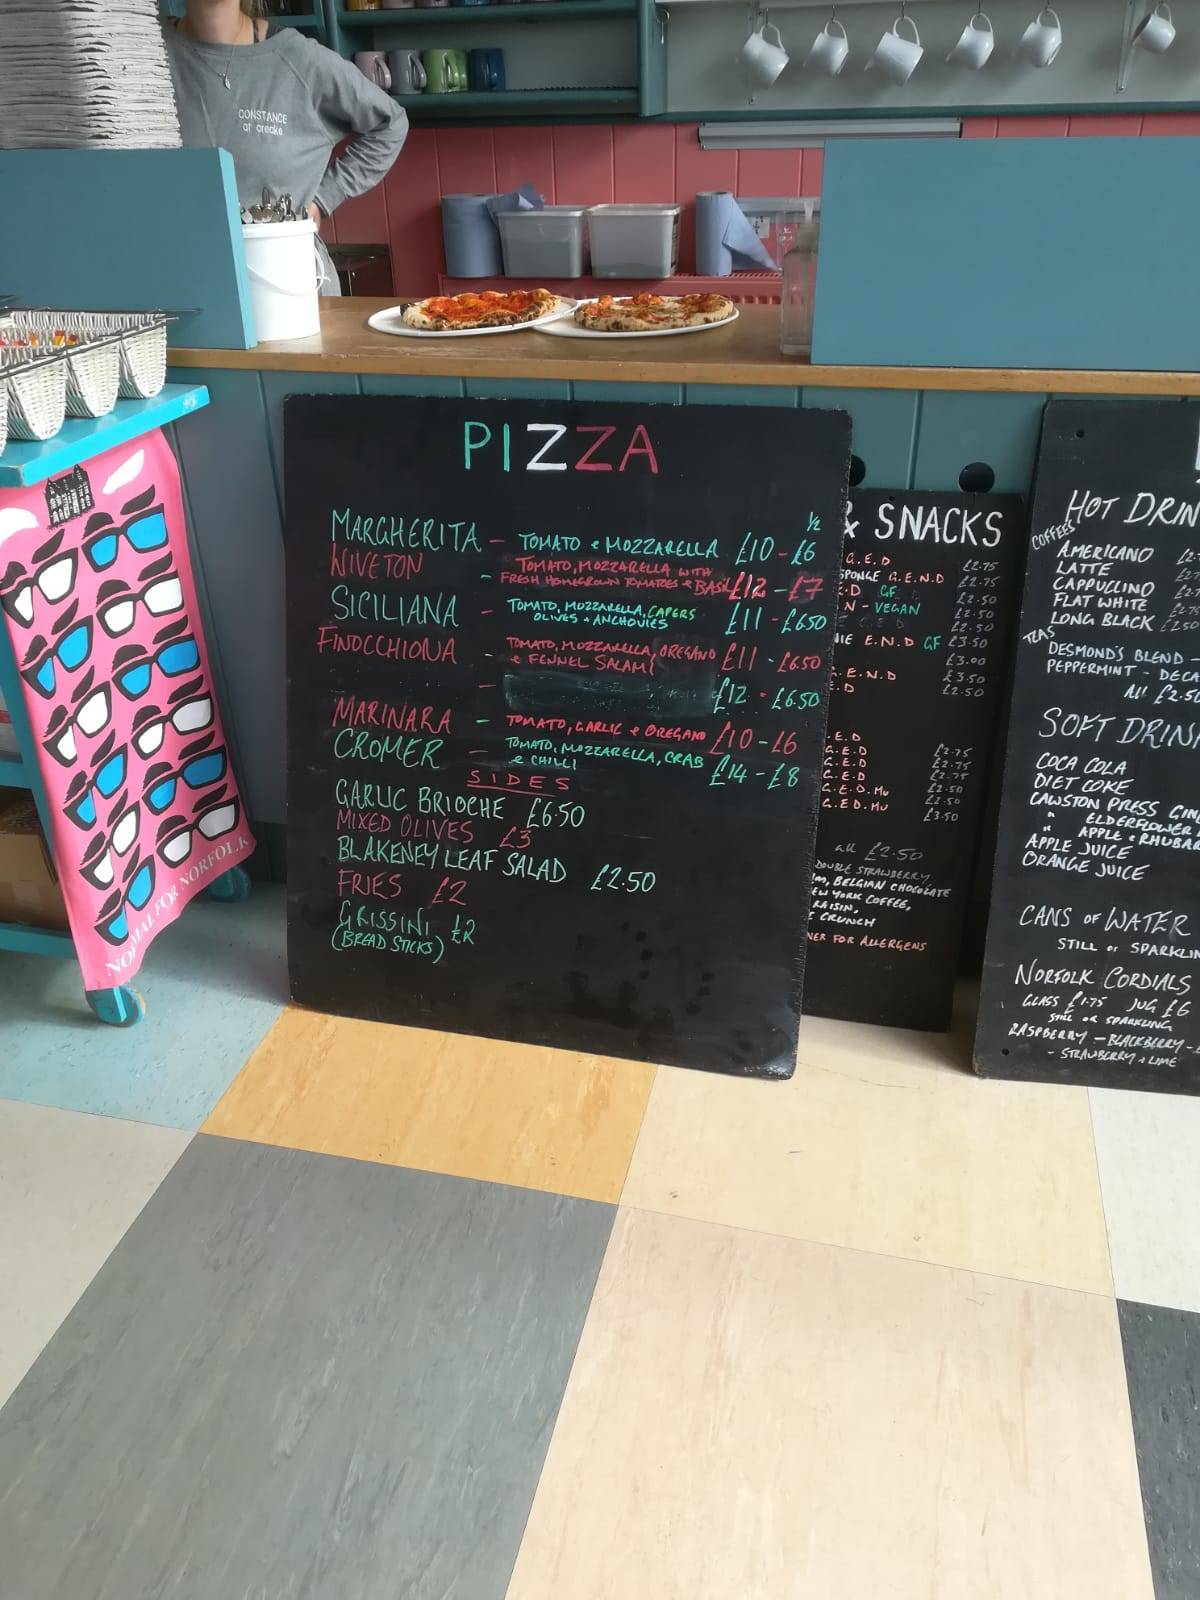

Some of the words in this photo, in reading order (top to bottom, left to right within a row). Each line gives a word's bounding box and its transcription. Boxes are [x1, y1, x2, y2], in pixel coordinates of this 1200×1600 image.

[238, 109, 288, 125] CONSTANCE
[242, 123, 251, 133] at
[464, 421, 659, 474] PIZZA
[1064, 490, 1120, 524] HOT
[874, 502, 1003, 547] SNACKS
[332, 507, 482, 553] MARGHERITA
[518, 532, 581, 553] TOMATO
[605, 536, 719, 559] MOZZARELLA
[735, 532, 775, 565] £10
[790, 539, 816, 567] £6
[1031, 519, 1077, 552] COFFEES
[1057, 540, 1155, 563] AMERICANO
[962, 559, 1000, 572] £2.75
[1056, 560, 1114, 577] LATTE
[500, 571, 541, 585] FRESH
[545, 574, 620, 588] HOMEGROWN
[515, 556, 578, 574] TOMATO,
[578, 559, 671, 577] MOZZARELLA
[728, 571, 767, 601] £12
[788, 575, 824, 603] £7
[957, 575, 1001, 588] £2.75
[1053, 576, 1155, 598] CAPPUCCINO
[879, 584, 898, 599] GF
[956, 591, 998, 605] £2.50
[1052, 591, 1095, 608] FLAT
[1097, 596, 1148, 612] WHITE
[331, 584, 459, 628] SICILIANA
[506, 597, 560, 613] TOMATO,
[564, 600, 647, 617] MOZZARELLA,
[647, 604, 697, 621] CAPERS
[724, 602, 763, 636] £11
[874, 601, 921, 615] VEGAN
[954, 607, 995, 620] £2.50
[533, 612, 578, 624] OLIVES
[592, 613, 669, 630] ANCHOVIES
[950, 621, 995, 633] £2.50
[1050, 611, 1095, 626] LONG
[1101, 612, 1156, 632] BLACK
[922, 636, 943, 651] GF
[947, 635, 988, 649] £3.50
[1022, 625, 1056, 645] TEAS
[317, 626, 458, 665] FINOCCHIONA
[506, 637, 559, 653] TOMATO,
[562, 640, 657, 659] MOZZARELLA,
[659, 644, 716, 662] OREGANO
[720, 643, 758, 673] £11
[777, 652, 822, 673] £6.50
[945, 653, 987, 667] £3.00
[1048, 641, 1125, 662] DESMOND'S
[1134, 649, 1184, 665] BLEND
[528, 654, 591, 669] FENNEL
[1047, 659, 1138, 677] PEPPERMINT
[943, 668, 986, 684] £3.50
[713, 677, 748, 714] £12
[771, 687, 820, 710] £6.50
[942, 683, 985, 697] £2.50
[332, 696, 451, 734] MARINARA
[506, 714, 572, 735] TOMATO,
[575, 721, 623, 736] GARLIC
[644, 724, 706, 742] OREGANO
[709, 720, 753, 756] £10
[771, 730, 798, 756] £6
[1038, 705, 1117, 742] SOFT
[333, 728, 443, 770] CROMER
[505, 736, 558, 754] TOMATO,
[561, 743, 661, 767] MOZZARELLA,
[664, 752, 705, 769] CRAB
[709, 753, 748, 787] £14
[768, 763, 800, 790] £8
[933, 743, 974, 758] £2.75
[531, 757, 577, 771] CHILLI
[931, 757, 973, 771] £2.75
[1035, 751, 1079, 772] COCA
[1083, 757, 1128, 776] COLA
[927, 782, 964, 794] £2.50
[1034, 772, 1081, 791] DIET
[1081, 778, 1135, 796] COKE
[336, 778, 407, 812] GARLIC
[418, 786, 507, 821] BRIOCHE
[525, 797, 585, 829] £6.50
[924, 794, 961, 806] £2.50
[1029, 791, 1100, 810] CAWSTON
[1106, 797, 1161, 818] PRESS
[922, 807, 959, 822] £3.50
[1085, 812, 1193, 836] ELDERFLOWER
[336, 809, 391, 834] MIXED
[400, 813, 474, 844] OLIVES
[498, 826, 533, 849] £3
[1077, 825, 1123, 842] APPLE
[863, 841, 924, 862] £2.50
[1024, 832, 1073, 853] APPLE
[1078, 842, 1134, 860] JUICE
[337, 835, 440, 870] BLAKENEY
[444, 847, 499, 873] LEAF
[501, 852, 567, 884] SALAD
[590, 863, 657, 893] £2.50
[814, 859, 853, 875] DOUBLE
[1022, 850, 1091, 873] ORANGE
[1095, 862, 1152, 881] JUICE
[154, 884, 180, 917] FOR
[178, 834, 250, 891] NORFOLK
[337, 868, 402, 900] FRIES
[430, 875, 468, 907] £2
[831, 889, 863, 901] YORK
[832, 875, 887, 891] BELGIAN
[889, 882, 952, 898] CHOCOLATE
[338, 899, 430, 937] GRISSINI
[450, 914, 476, 945] £2
[819, 911, 877, 928] CRUNCH
[1019, 904, 1073, 928] CANS
[1104, 906, 1192, 937] WATER
[832, 934, 855, 945] FOR
[859, 935, 928, 952] ALLERGENS
[1057, 937, 1099, 952] STILL
[1014, 957, 1096, 986] NORFOLK
[1103, 966, 1193, 996] CORDIALS
[1021, 993, 1061, 1008] GLASS
[1125, 997, 1159, 1013] JUG
[1161, 998, 1193, 1018] £6
[1047, 1012, 1073, 1023] STILL
[1105, 1016, 1174, 1032] SPARKLING
[1007, 1022, 1088, 1045] RASPBERRY
[1107, 1032, 1186, 1054] BLACKBERRY
[1060, 1047, 1137, 1065] STRAWBERRY
[1147, 1056, 1178, 1068] LIME
